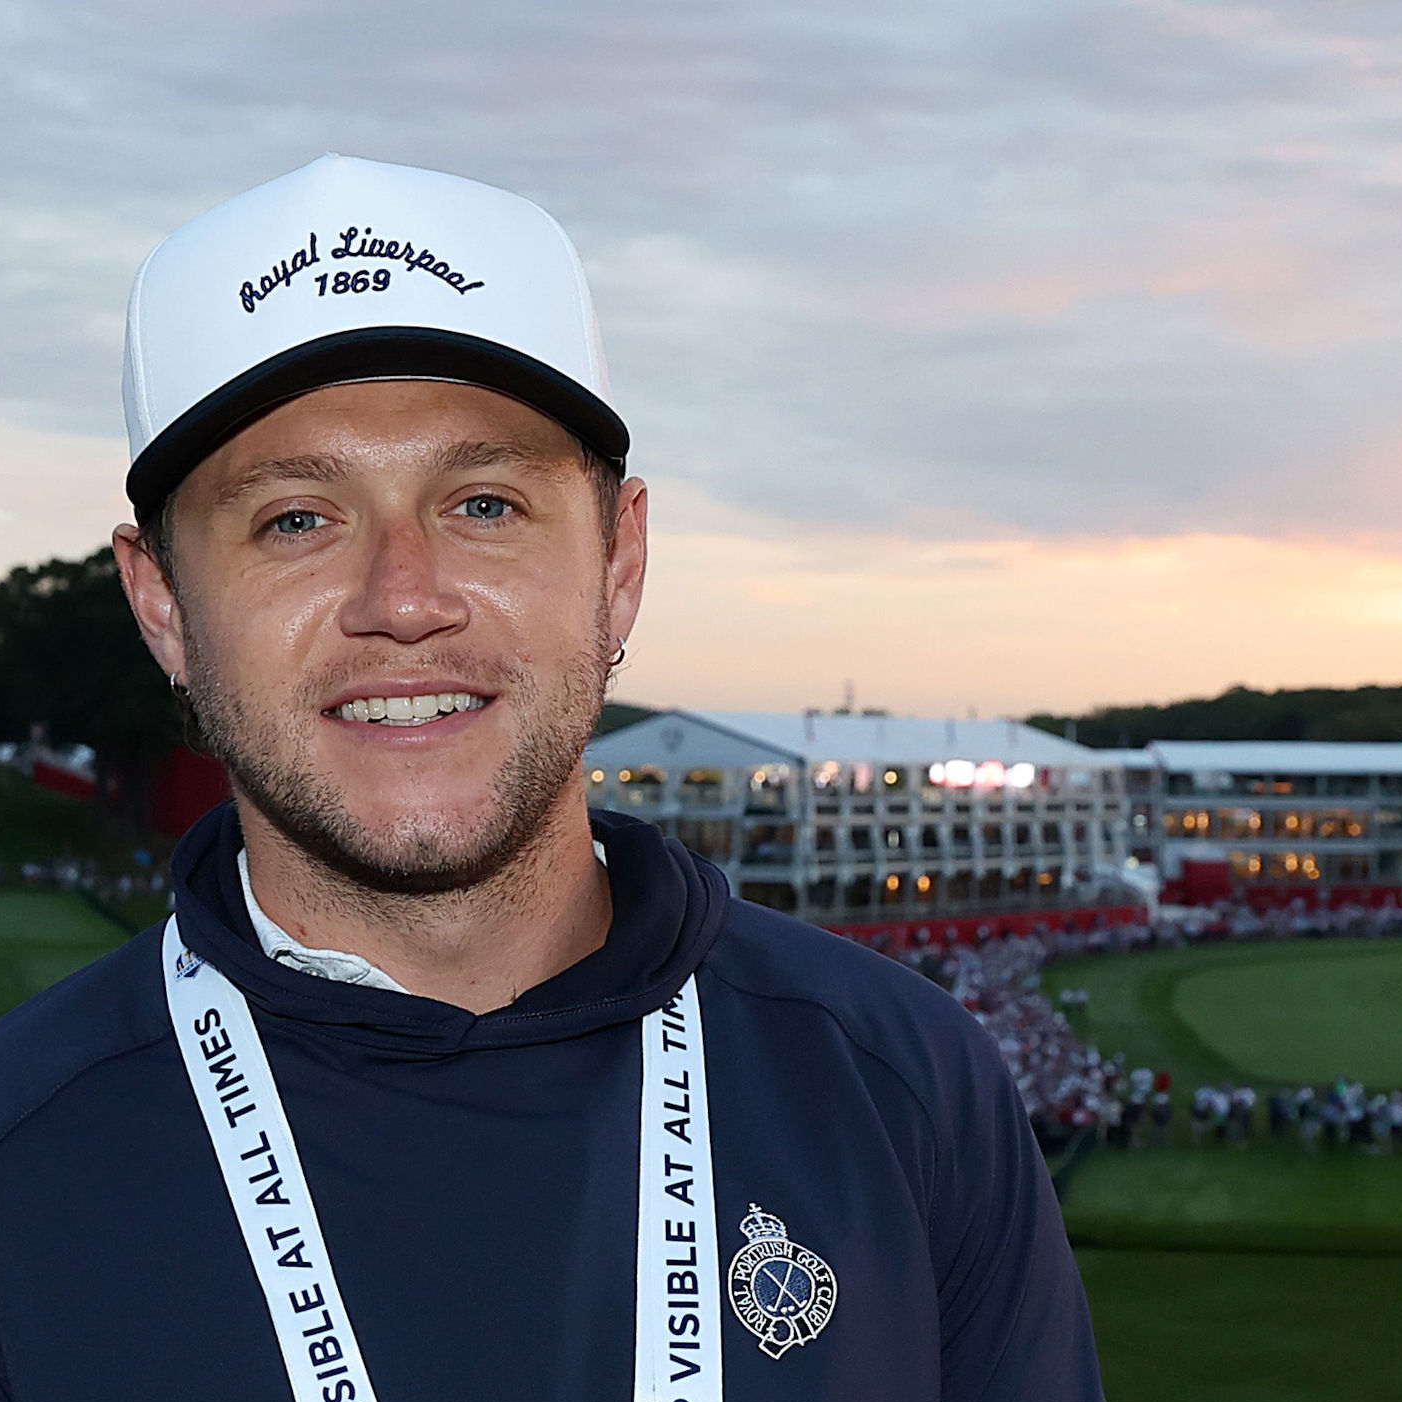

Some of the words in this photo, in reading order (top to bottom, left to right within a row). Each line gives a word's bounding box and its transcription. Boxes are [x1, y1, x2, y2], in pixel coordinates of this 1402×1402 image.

[238, 232, 321, 313] Royal
[331, 227, 485, 296] Liverpool
[314, 268, 391, 297] 1869
[194, 1008, 257, 1129] TIMES
[663, 1070, 692, 1145] ALL
[240, 1130, 291, 1205] ALL
[664, 1153, 695, 1207] AT
[265, 1226, 313, 1269] AT
[733, 1241, 794, 1281] PORTRUSH
[796, 1251, 831, 1283] GOLF
[665, 1219, 701, 1383] VISIBLE
[733, 1285, 768, 1333] ROYAL
[807, 1286, 833, 1327] CLUB
